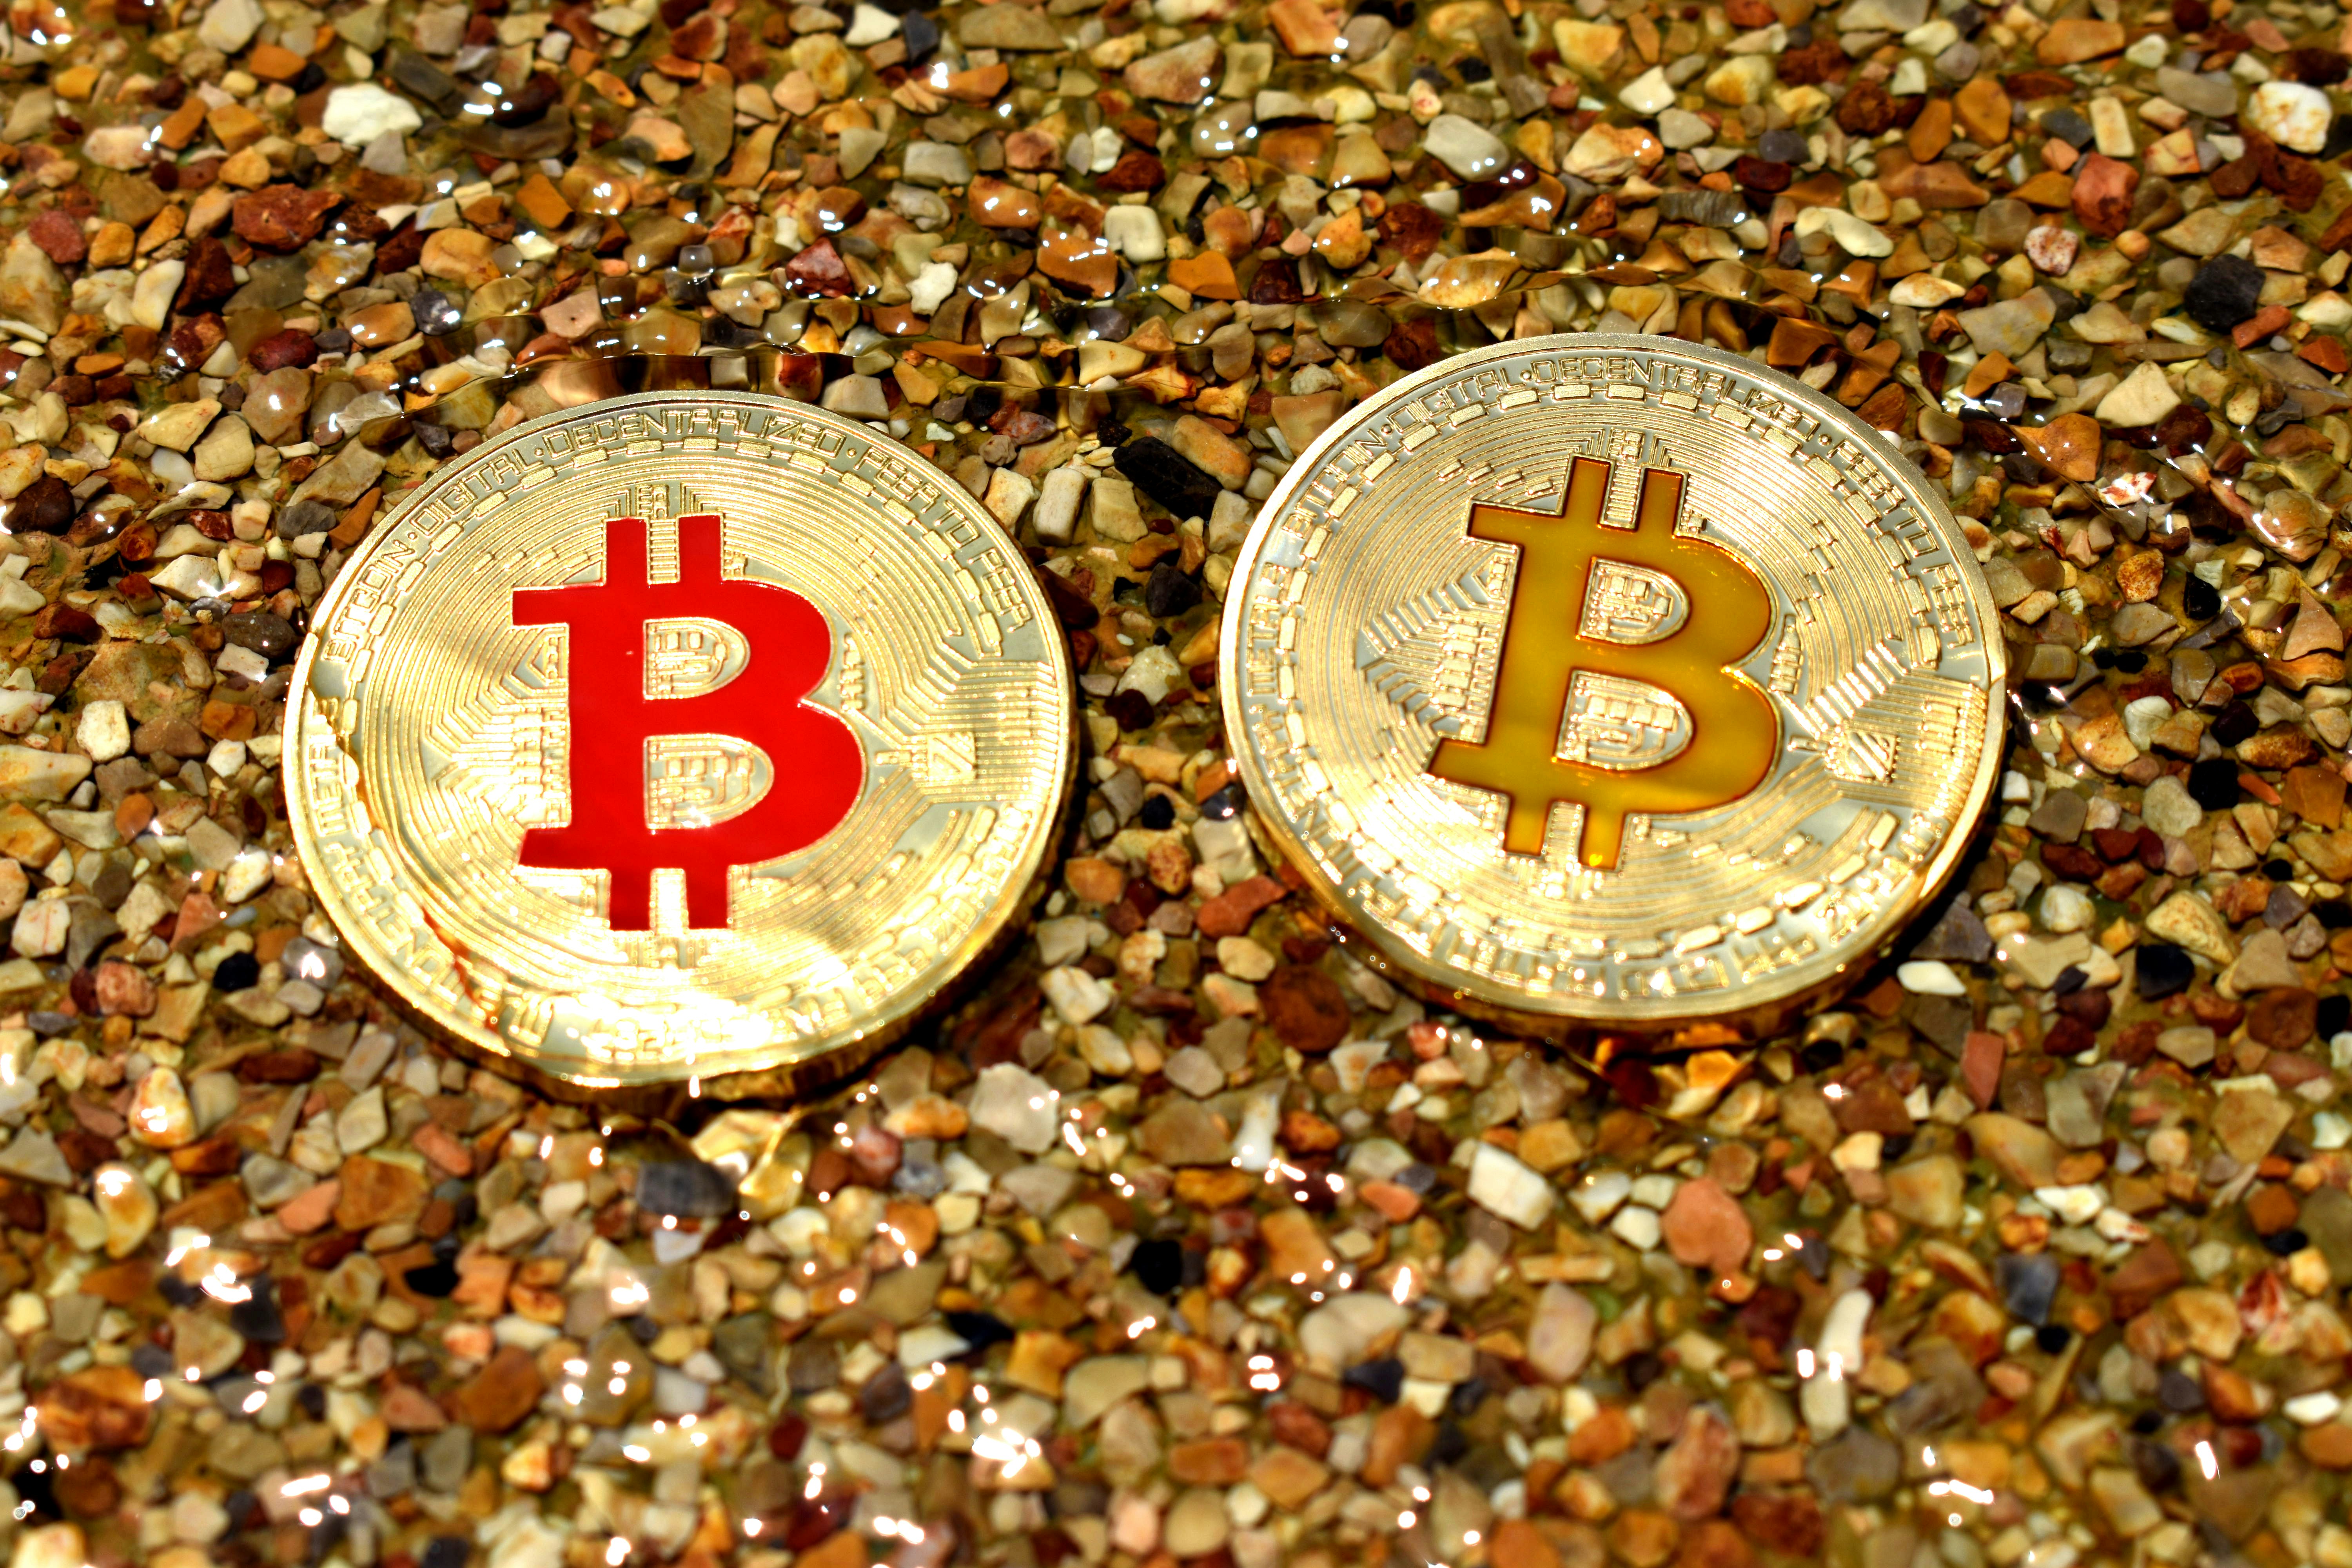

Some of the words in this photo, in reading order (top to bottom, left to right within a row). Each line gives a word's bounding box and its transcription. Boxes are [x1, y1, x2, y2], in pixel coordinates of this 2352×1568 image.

[323, 537, 414, 663] BITCOIN
[409, 444, 539, 536] DIGITAL
[544, 412, 846, 459] DECENTRALIZED
[855, 447, 944, 513] PEER
[928, 500, 981, 547] TO
[969, 547, 1036, 631] PEER
[1247, 562, 1289, 694] METALS
[1281, 429, 1387, 539] BITCOIN
[1387, 365, 1524, 434] DIGITAL
[1534, 358, 1821, 441] DECENTRALIZED
[1827, 439, 1907, 513] PEER
[1891, 506, 1938, 557] TO
[1922, 563, 1973, 648] PEER
